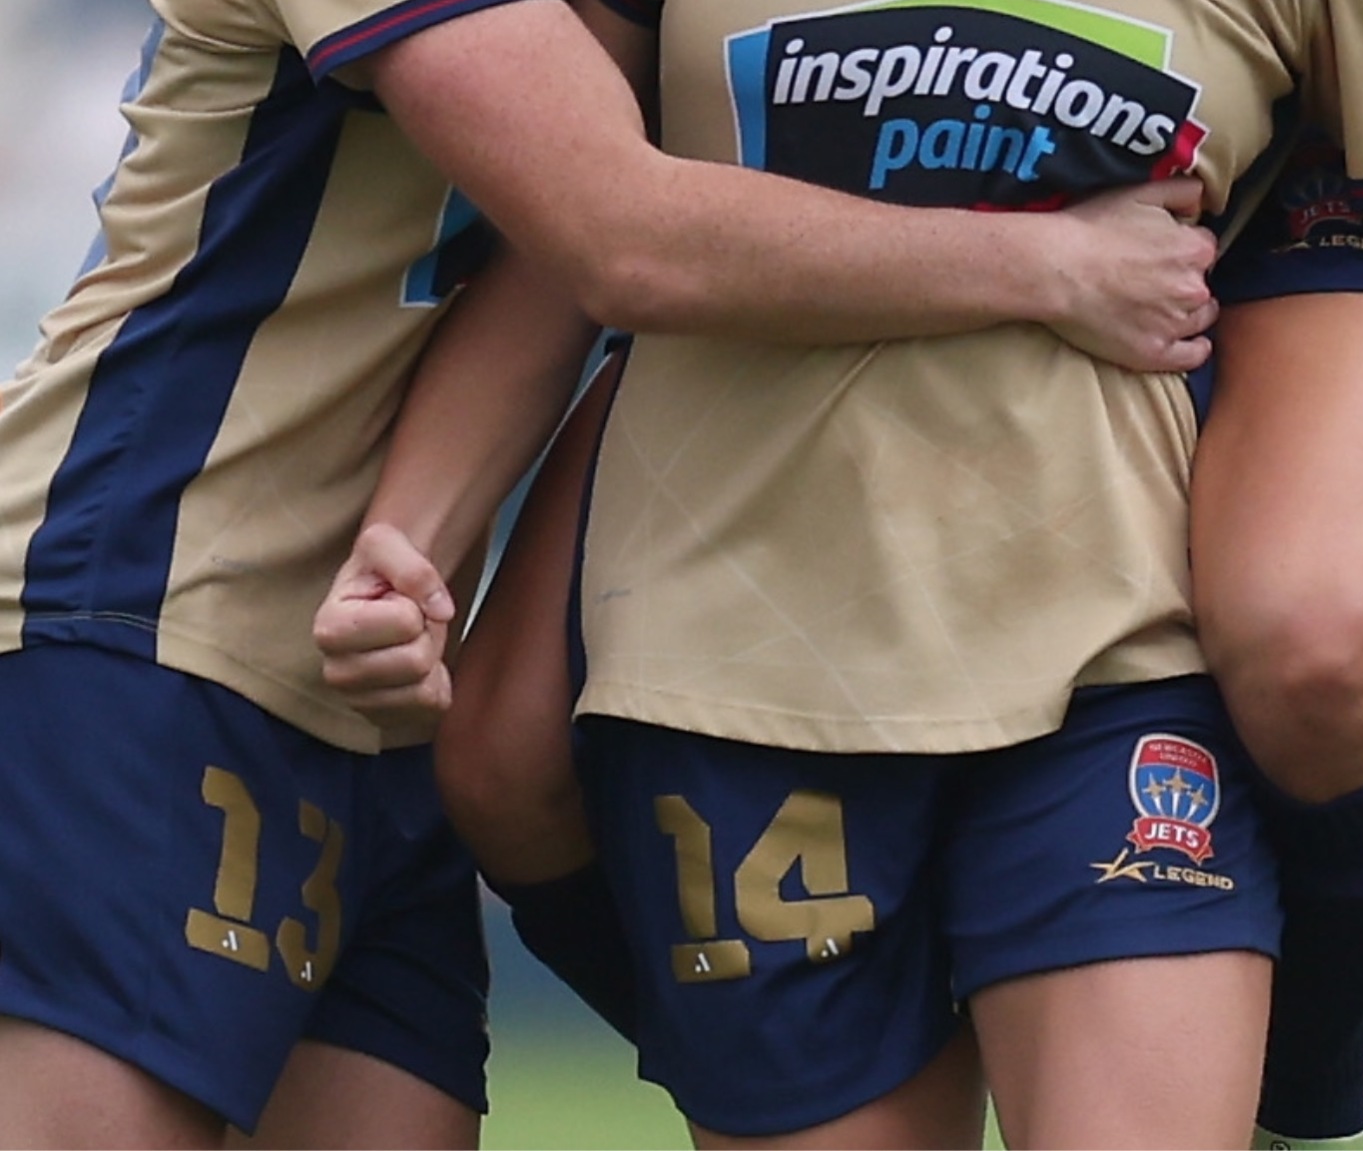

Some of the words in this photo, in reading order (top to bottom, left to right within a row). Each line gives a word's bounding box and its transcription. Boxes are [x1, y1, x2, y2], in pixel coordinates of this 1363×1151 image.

[773, 26, 1176, 156] inspirations
[868, 104, 1057, 189] paint
[185, 766, 344, 992] 13
[655, 791, 875, 983] 14
[1144, 823, 1200, 848] JETS
[1153, 864, 1235, 890] LEGEND
